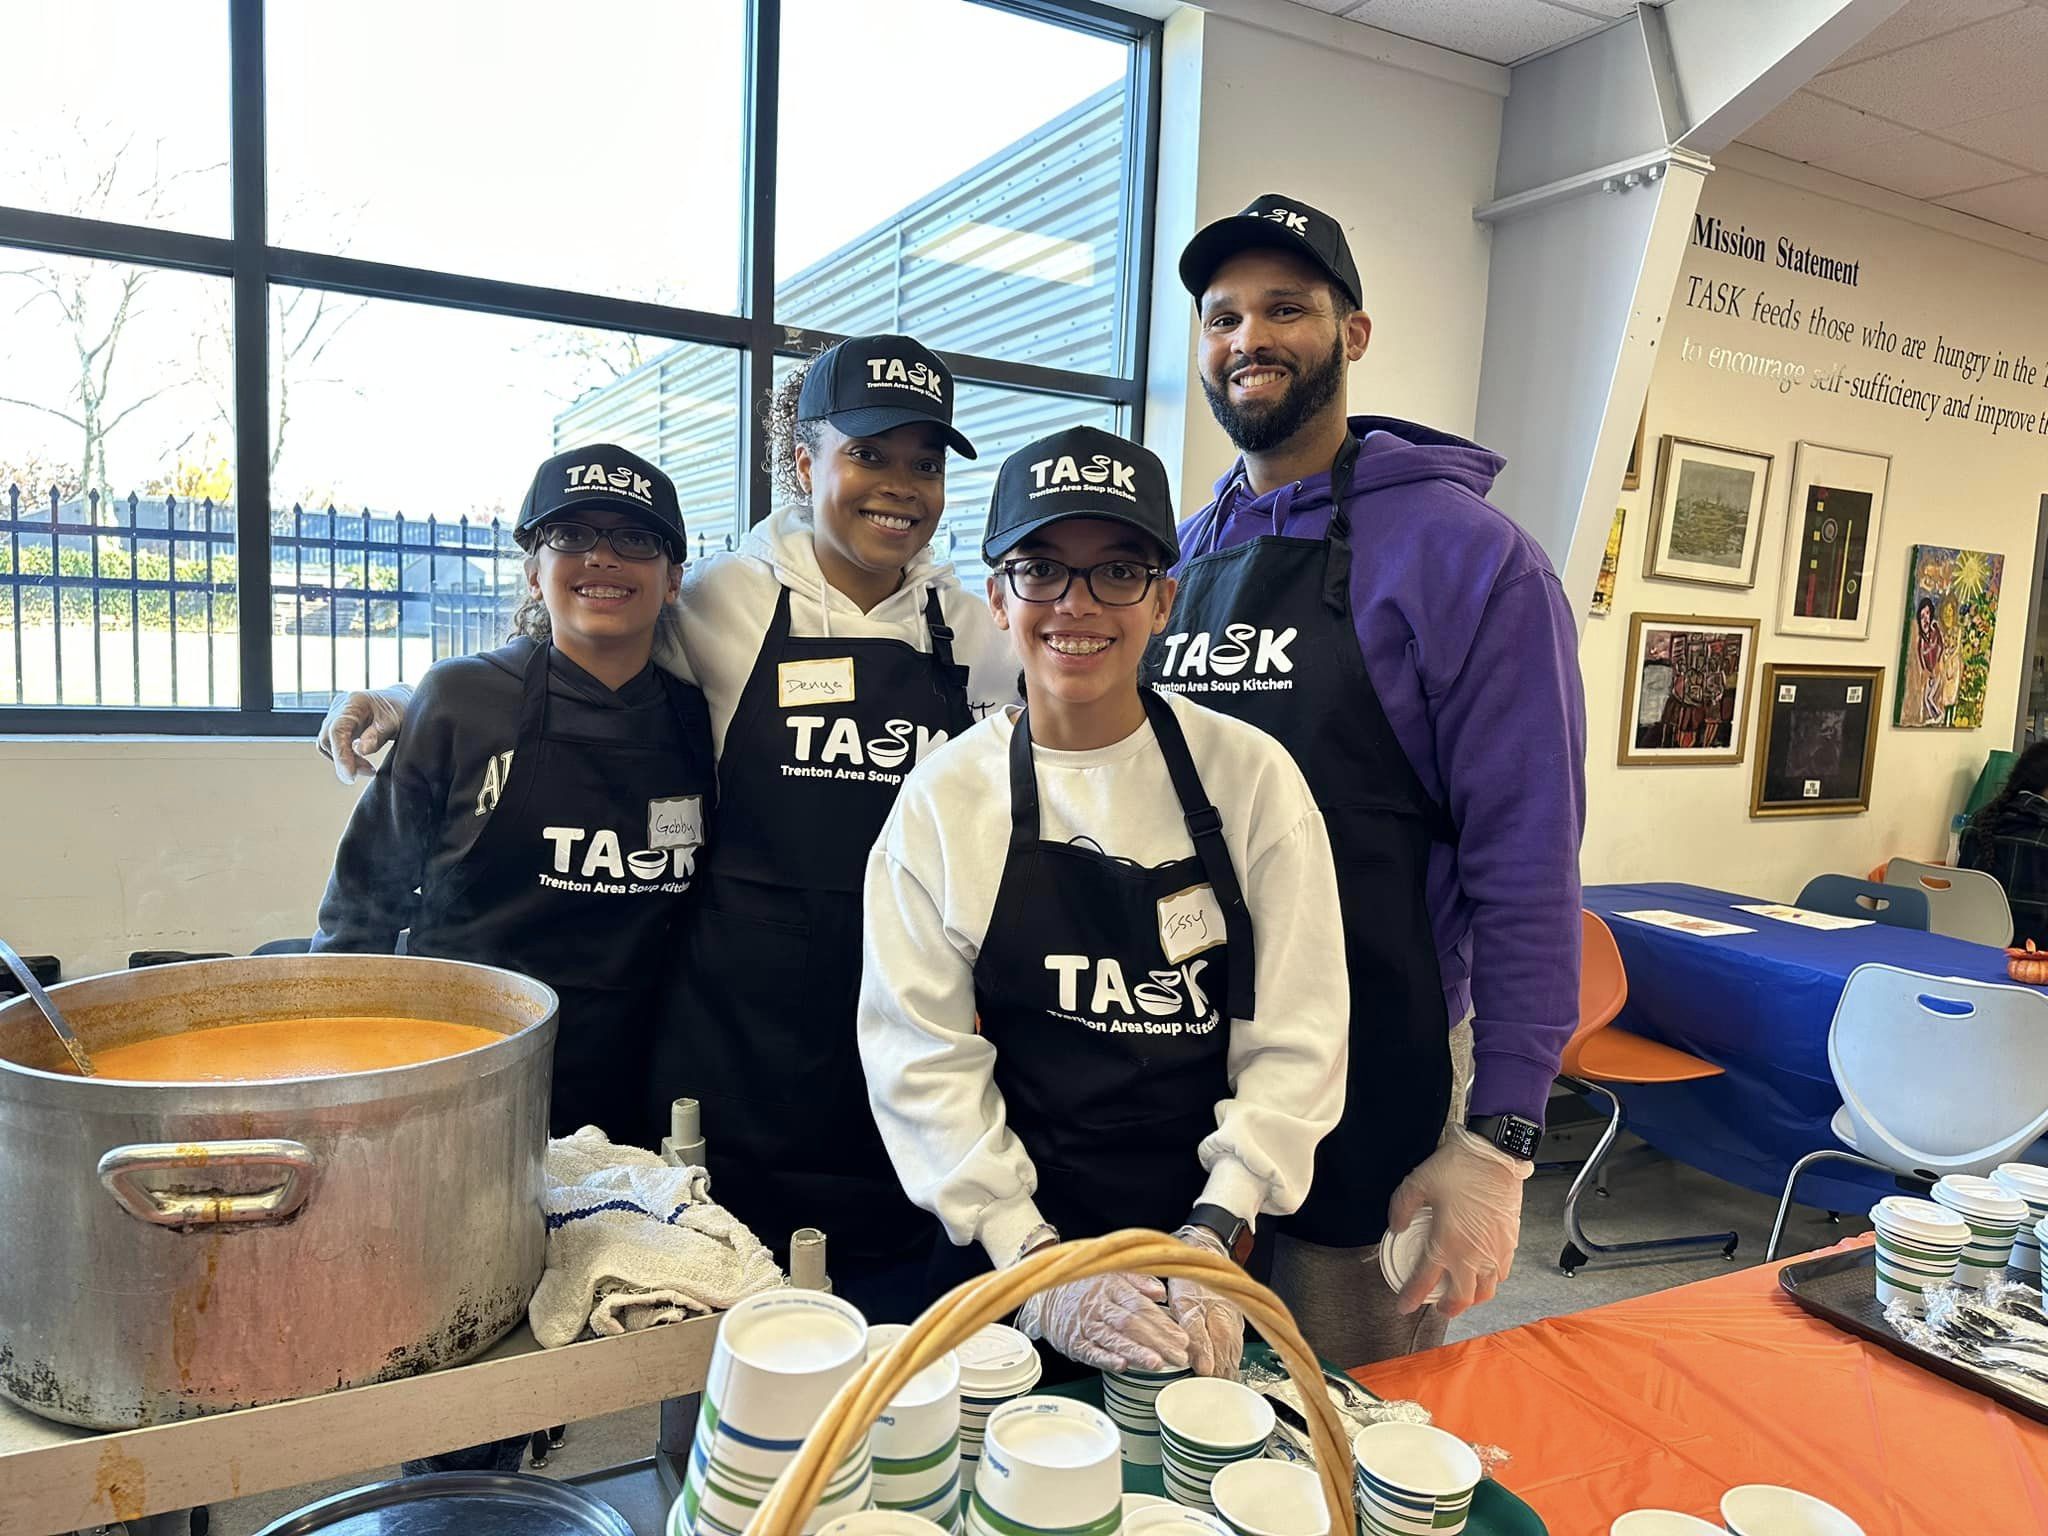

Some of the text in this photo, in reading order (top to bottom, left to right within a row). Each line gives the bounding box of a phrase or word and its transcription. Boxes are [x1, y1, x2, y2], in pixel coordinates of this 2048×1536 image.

[1692, 212, 1859, 286] Mission Statement
[1685, 275, 1746, 317] TASK
[1752, 291, 1801, 331] feeds
[1808, 306, 1855, 343] those
[1861, 321, 1897, 353] who
[1901, 336, 1926, 359] are
[1933, 336, 1991, 382] hungry
[1993, 351, 2009, 378] in
[2013, 355, 2037, 385] the
[867, 359, 942, 396] TASK
[1681, 336, 1702, 361] to
[1708, 346, 1805, 393] encourage
[1810, 363, 1941, 422] self-sufficiency
[1943, 394, 1973, 420] and
[1975, 396, 2036, 435] improve
[566, 464, 652, 499] TASK
[1030, 454, 1136, 493] TASK
[1060, 484, 1081, 492] Area
[1082, 484, 1106, 494] Soup
[1161, 623, 1297, 677] TASK
[1151, 678, 1293, 694] Trenton Area Soup Kitchen
[780, 765, 832, 778] Trenton
[834, 768, 865, 780] Area
[868, 770, 901, 785] Soup
[538, 873, 592, 892] Trenton
[593, 882, 626, 894] Area
[628, 882, 660, 893] Soup
[1044, 954, 1208, 1019] TASK
[1109, 1019, 1143, 1033] Area
[1143, 1021, 1182, 1036] Soup
